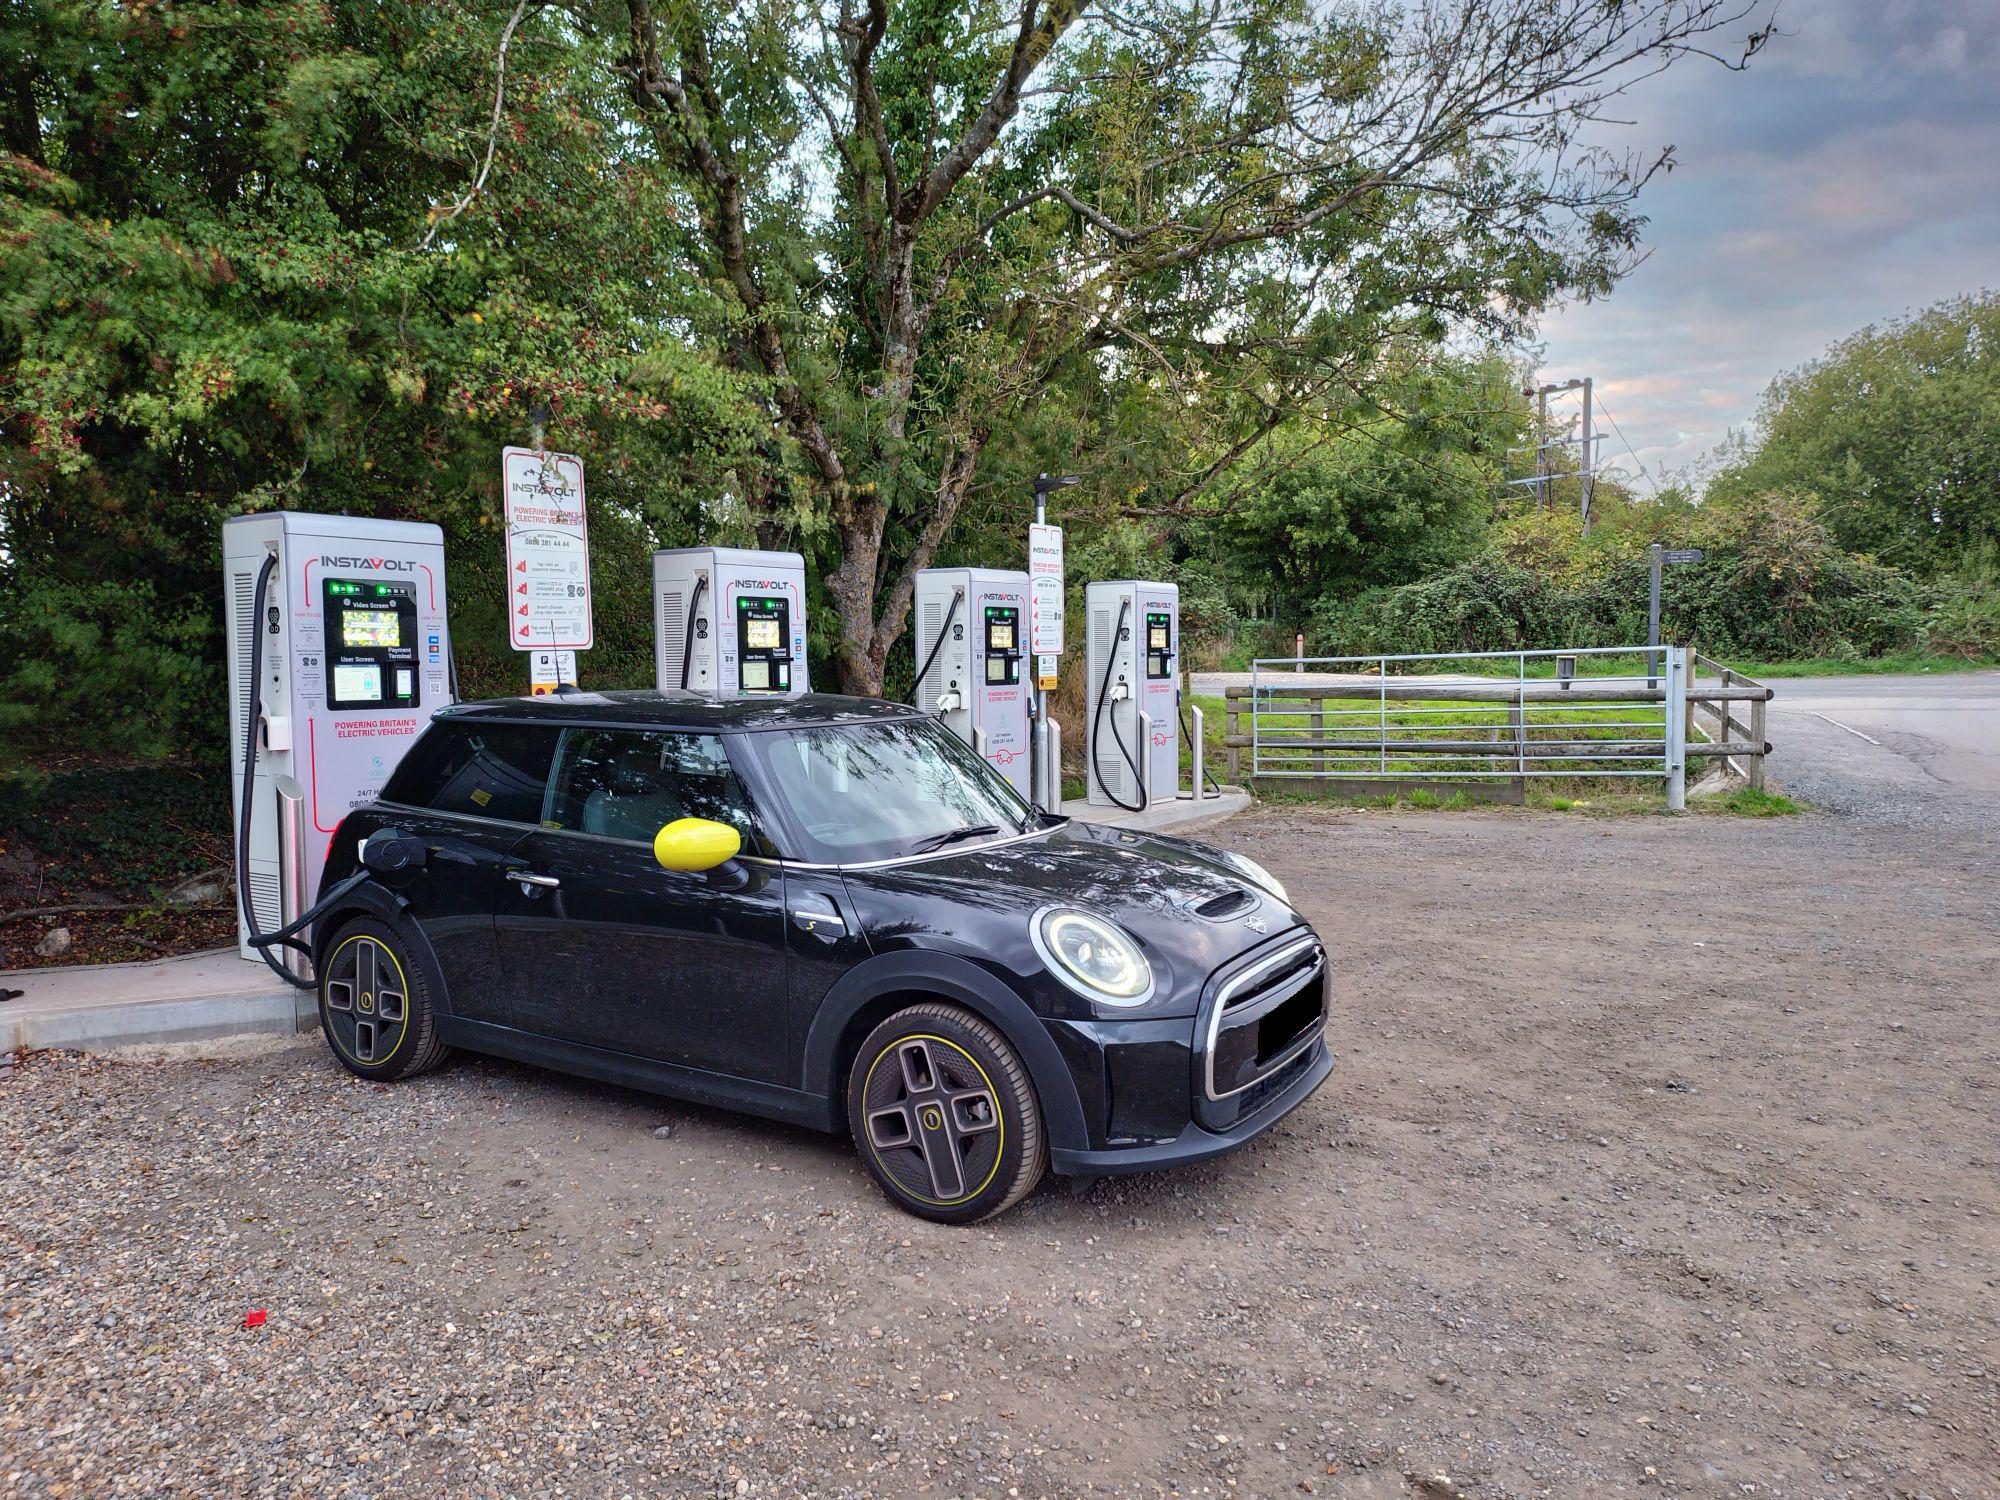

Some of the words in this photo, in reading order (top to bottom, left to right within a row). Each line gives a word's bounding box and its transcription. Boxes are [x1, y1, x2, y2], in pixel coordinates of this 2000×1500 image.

[512, 482, 576, 497] INSTAVOLT
[513, 506, 548, 515] POWERING
[516, 514, 546, 523] ELECTRIC
[321, 555, 416, 572] INSTAVOLT
[735, 580, 789, 590] INSTAVOLT
[983, 593, 1019, 601] INSTAVOLT
[334, 720, 378, 730] POWERING
[379, 719, 417, 728] BRITAIN'S
[338, 729, 375, 738] ELECTRIC
[377, 727, 414, 736] VEHICLES
[357, 789, 372, 797] 24/7
[805, 920, 817, 930] S
